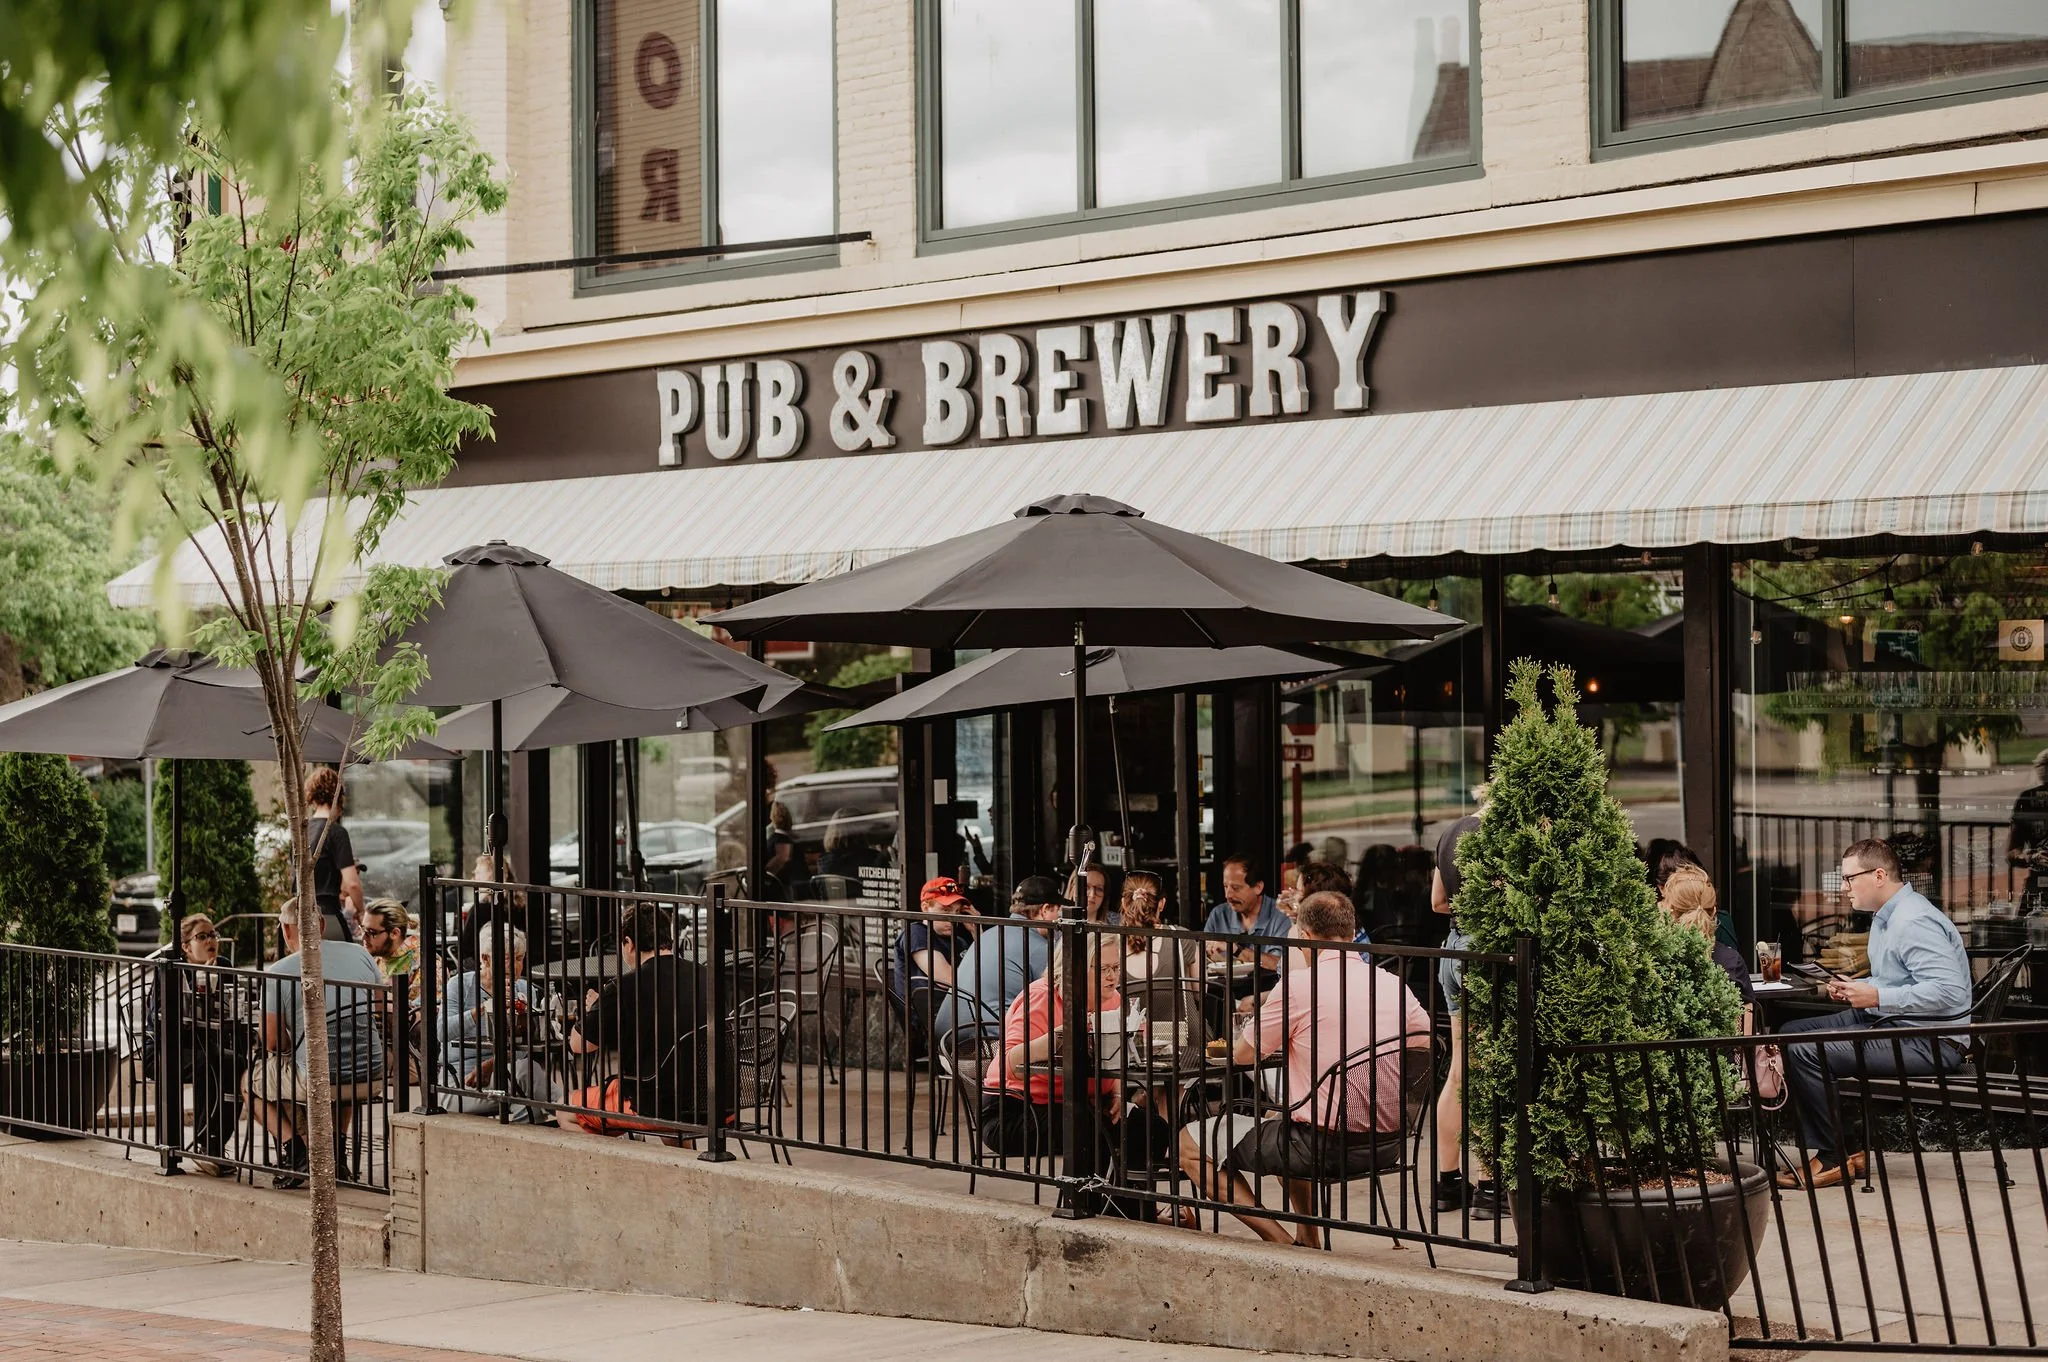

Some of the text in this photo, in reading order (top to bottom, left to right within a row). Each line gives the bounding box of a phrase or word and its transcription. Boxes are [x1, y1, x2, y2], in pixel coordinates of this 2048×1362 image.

[657, 290, 1389, 466] PUB & BREWERY
[858, 866, 900, 880] KITCHEN HOU
